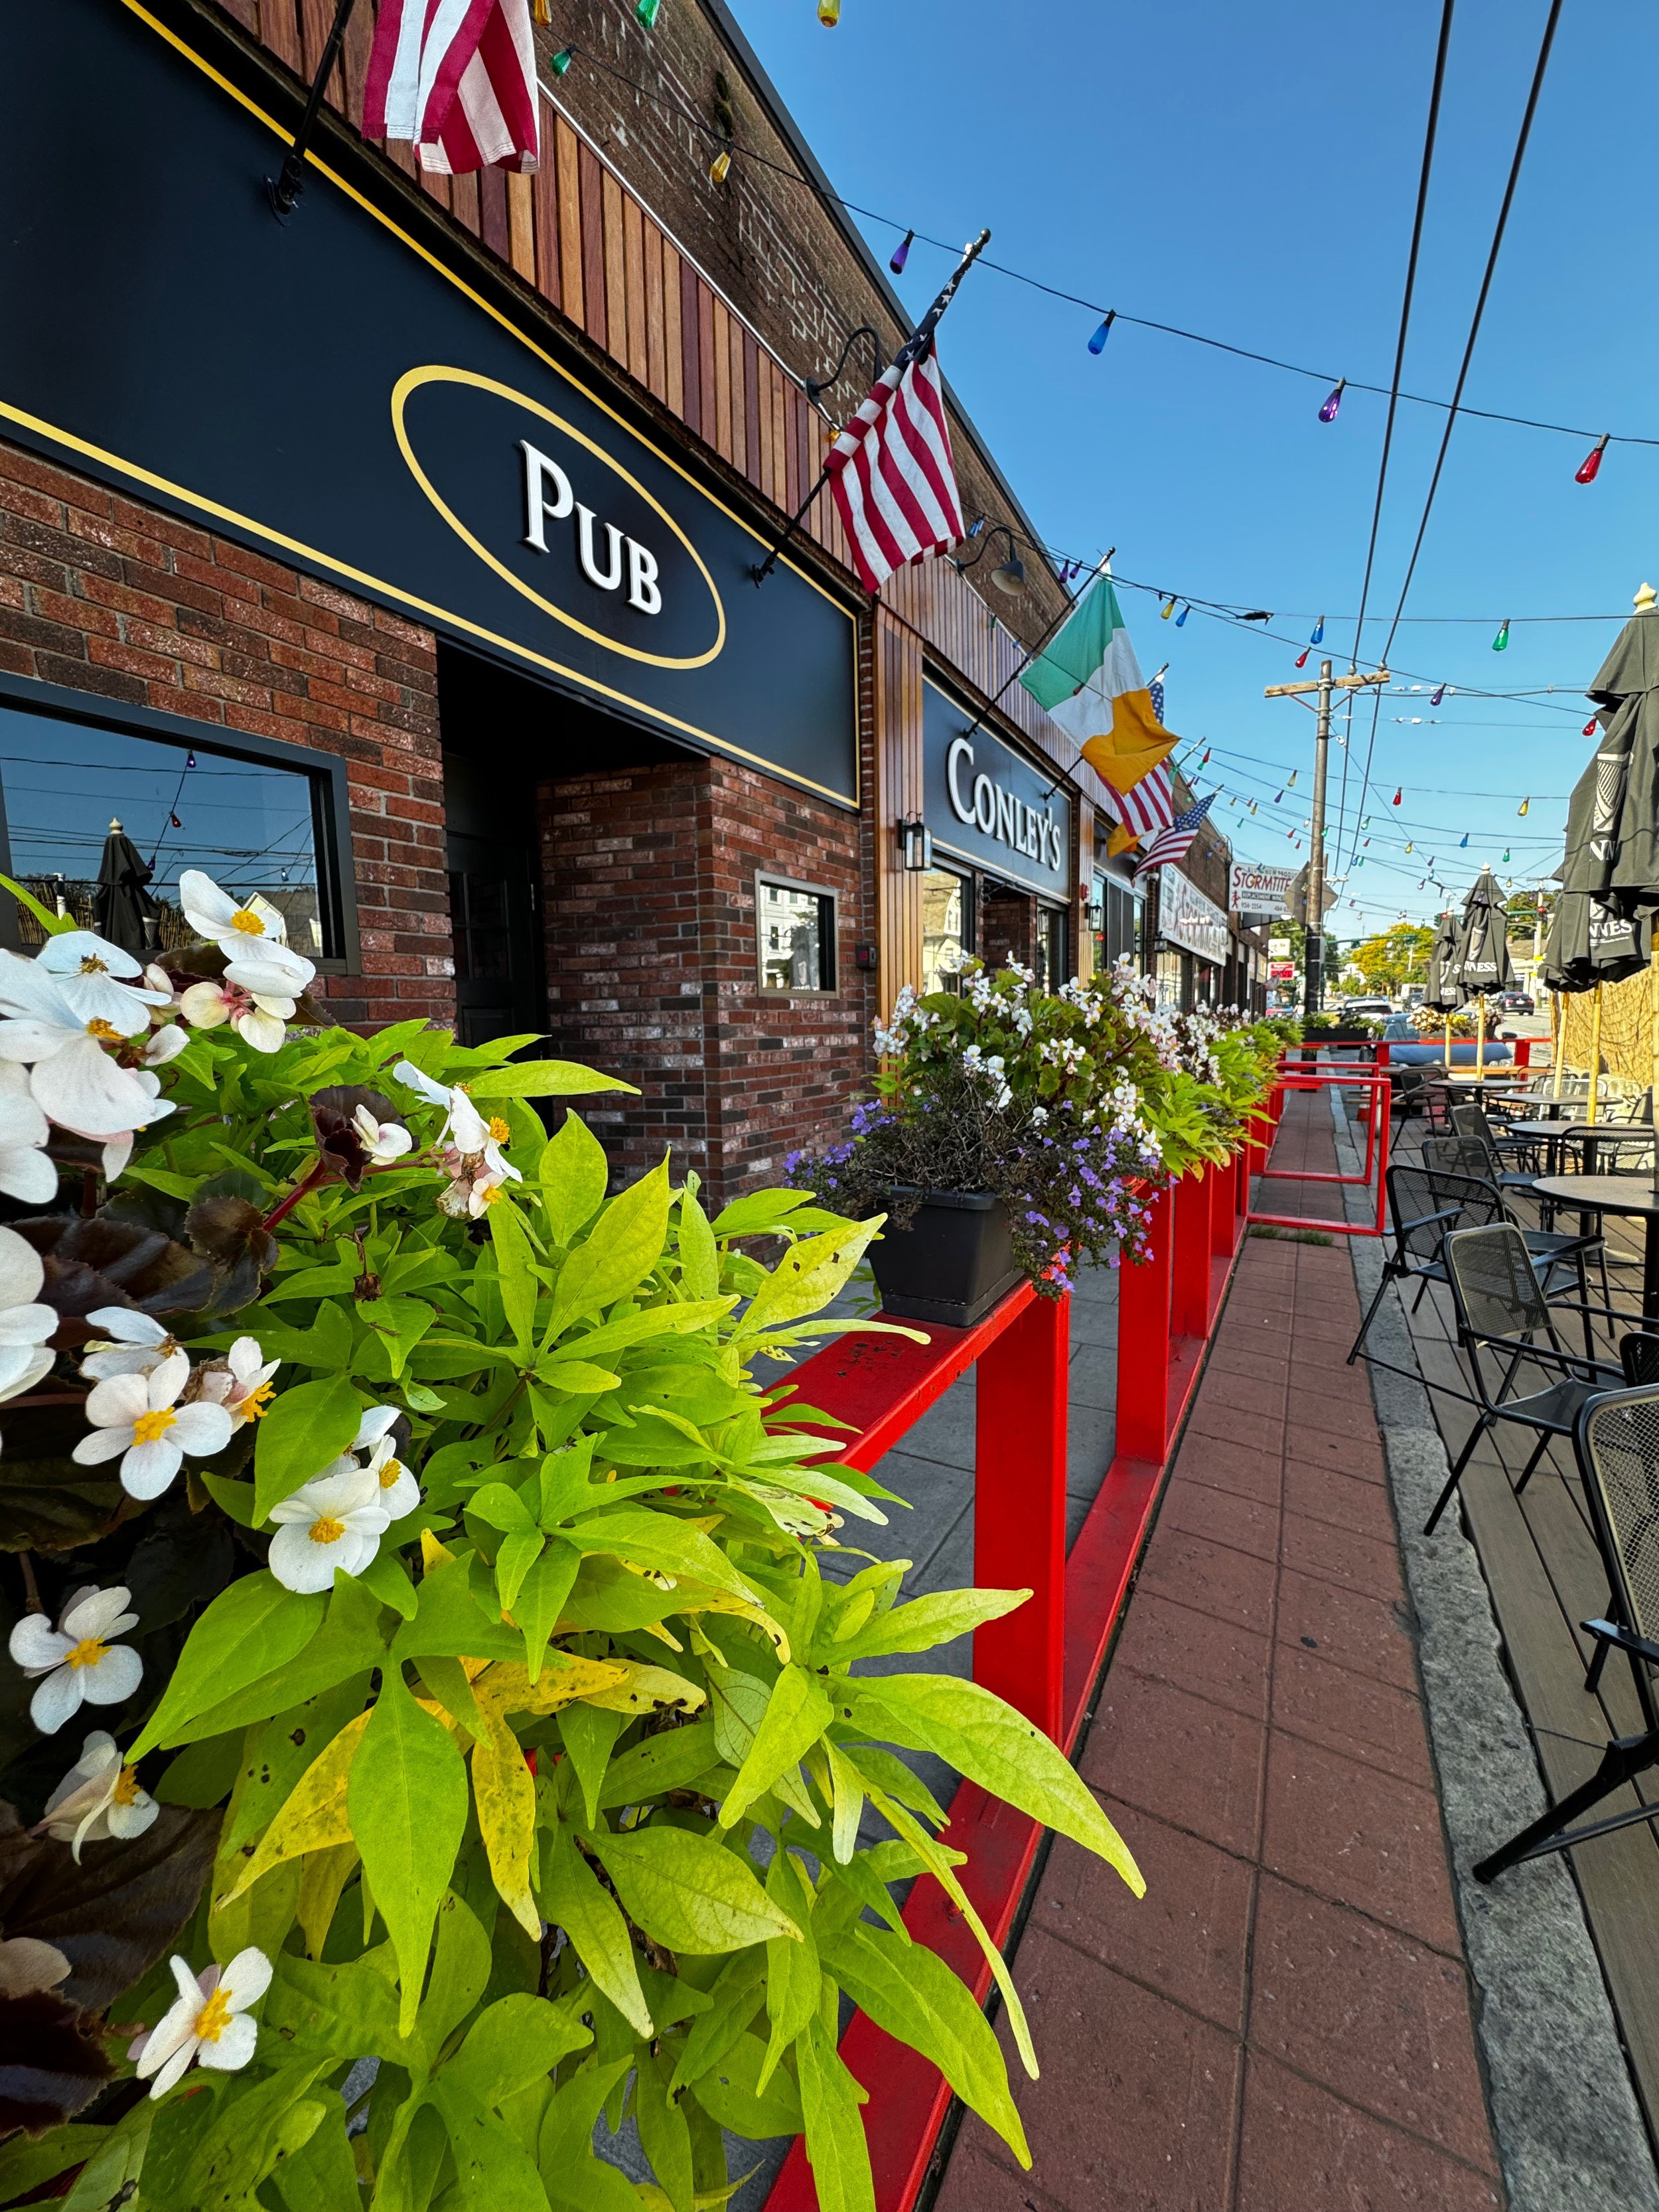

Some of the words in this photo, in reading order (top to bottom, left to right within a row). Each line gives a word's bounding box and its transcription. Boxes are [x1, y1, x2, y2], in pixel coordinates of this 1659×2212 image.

[520, 439, 662, 615] PUB
[948, 738, 1061, 872] CONLEY'S
[1232, 866, 1292, 893] STORMTITE
